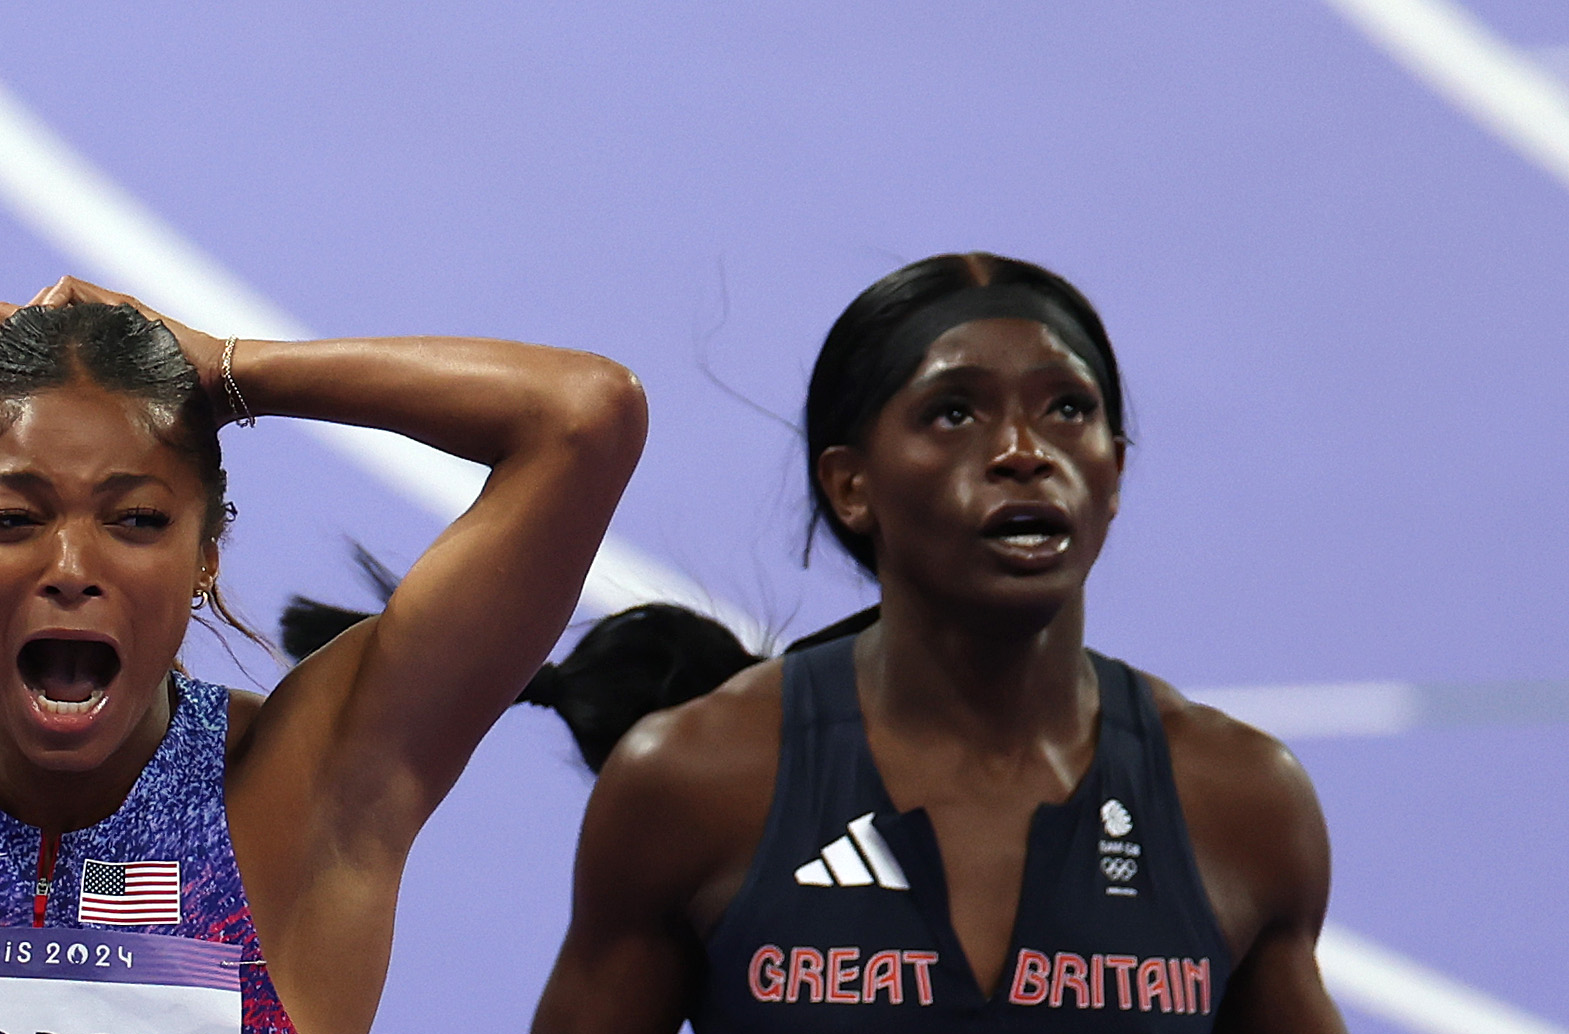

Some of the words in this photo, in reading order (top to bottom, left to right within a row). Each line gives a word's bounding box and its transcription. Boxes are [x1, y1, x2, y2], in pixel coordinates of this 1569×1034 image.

[45, 942, 133, 969] 2024
[748, 945, 939, 1006] GREAT
[1008, 948, 1211, 1015] BRITAIN
